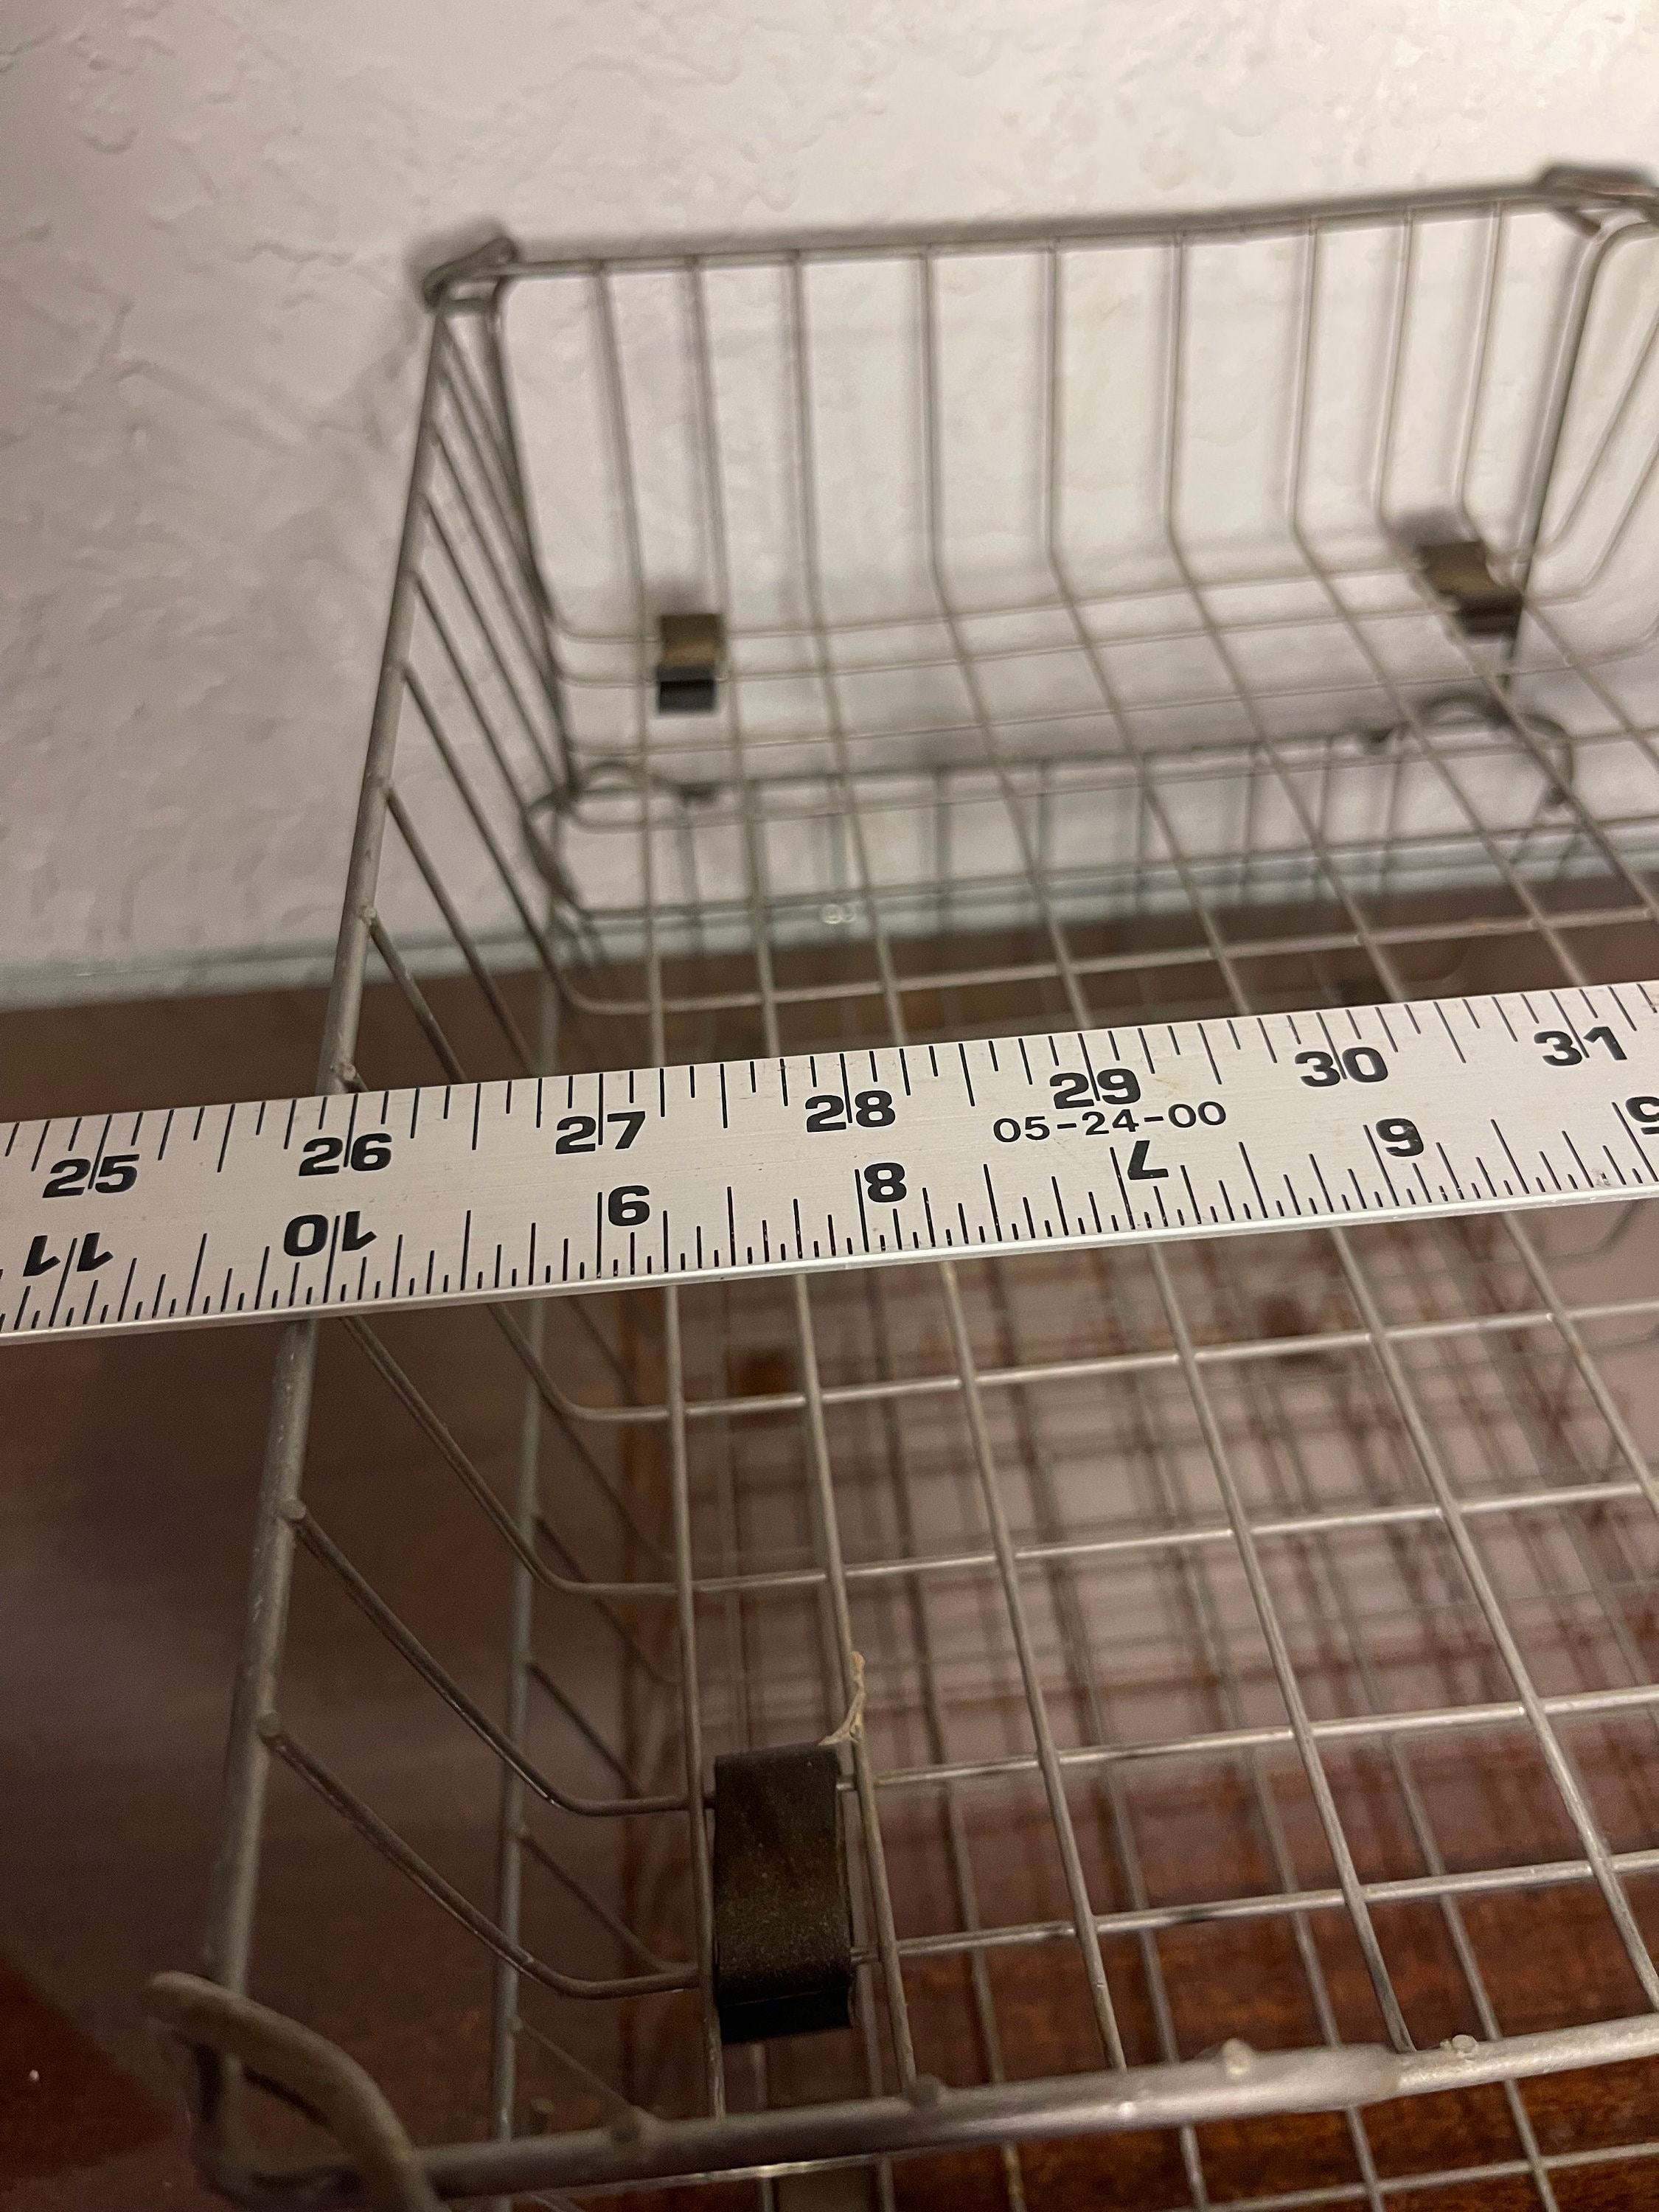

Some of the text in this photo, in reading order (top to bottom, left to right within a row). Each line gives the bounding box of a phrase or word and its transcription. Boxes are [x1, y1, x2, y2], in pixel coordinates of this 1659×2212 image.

[42, 1026, 1627, 1198] 25 26 27 28 29 30 31
[993, 1102, 1226, 1142] 05-24-00
[1127, 1140, 1169, 1180] 7
[864, 1163, 907, 1203] 8
[284, 1211, 377, 1256] 10
